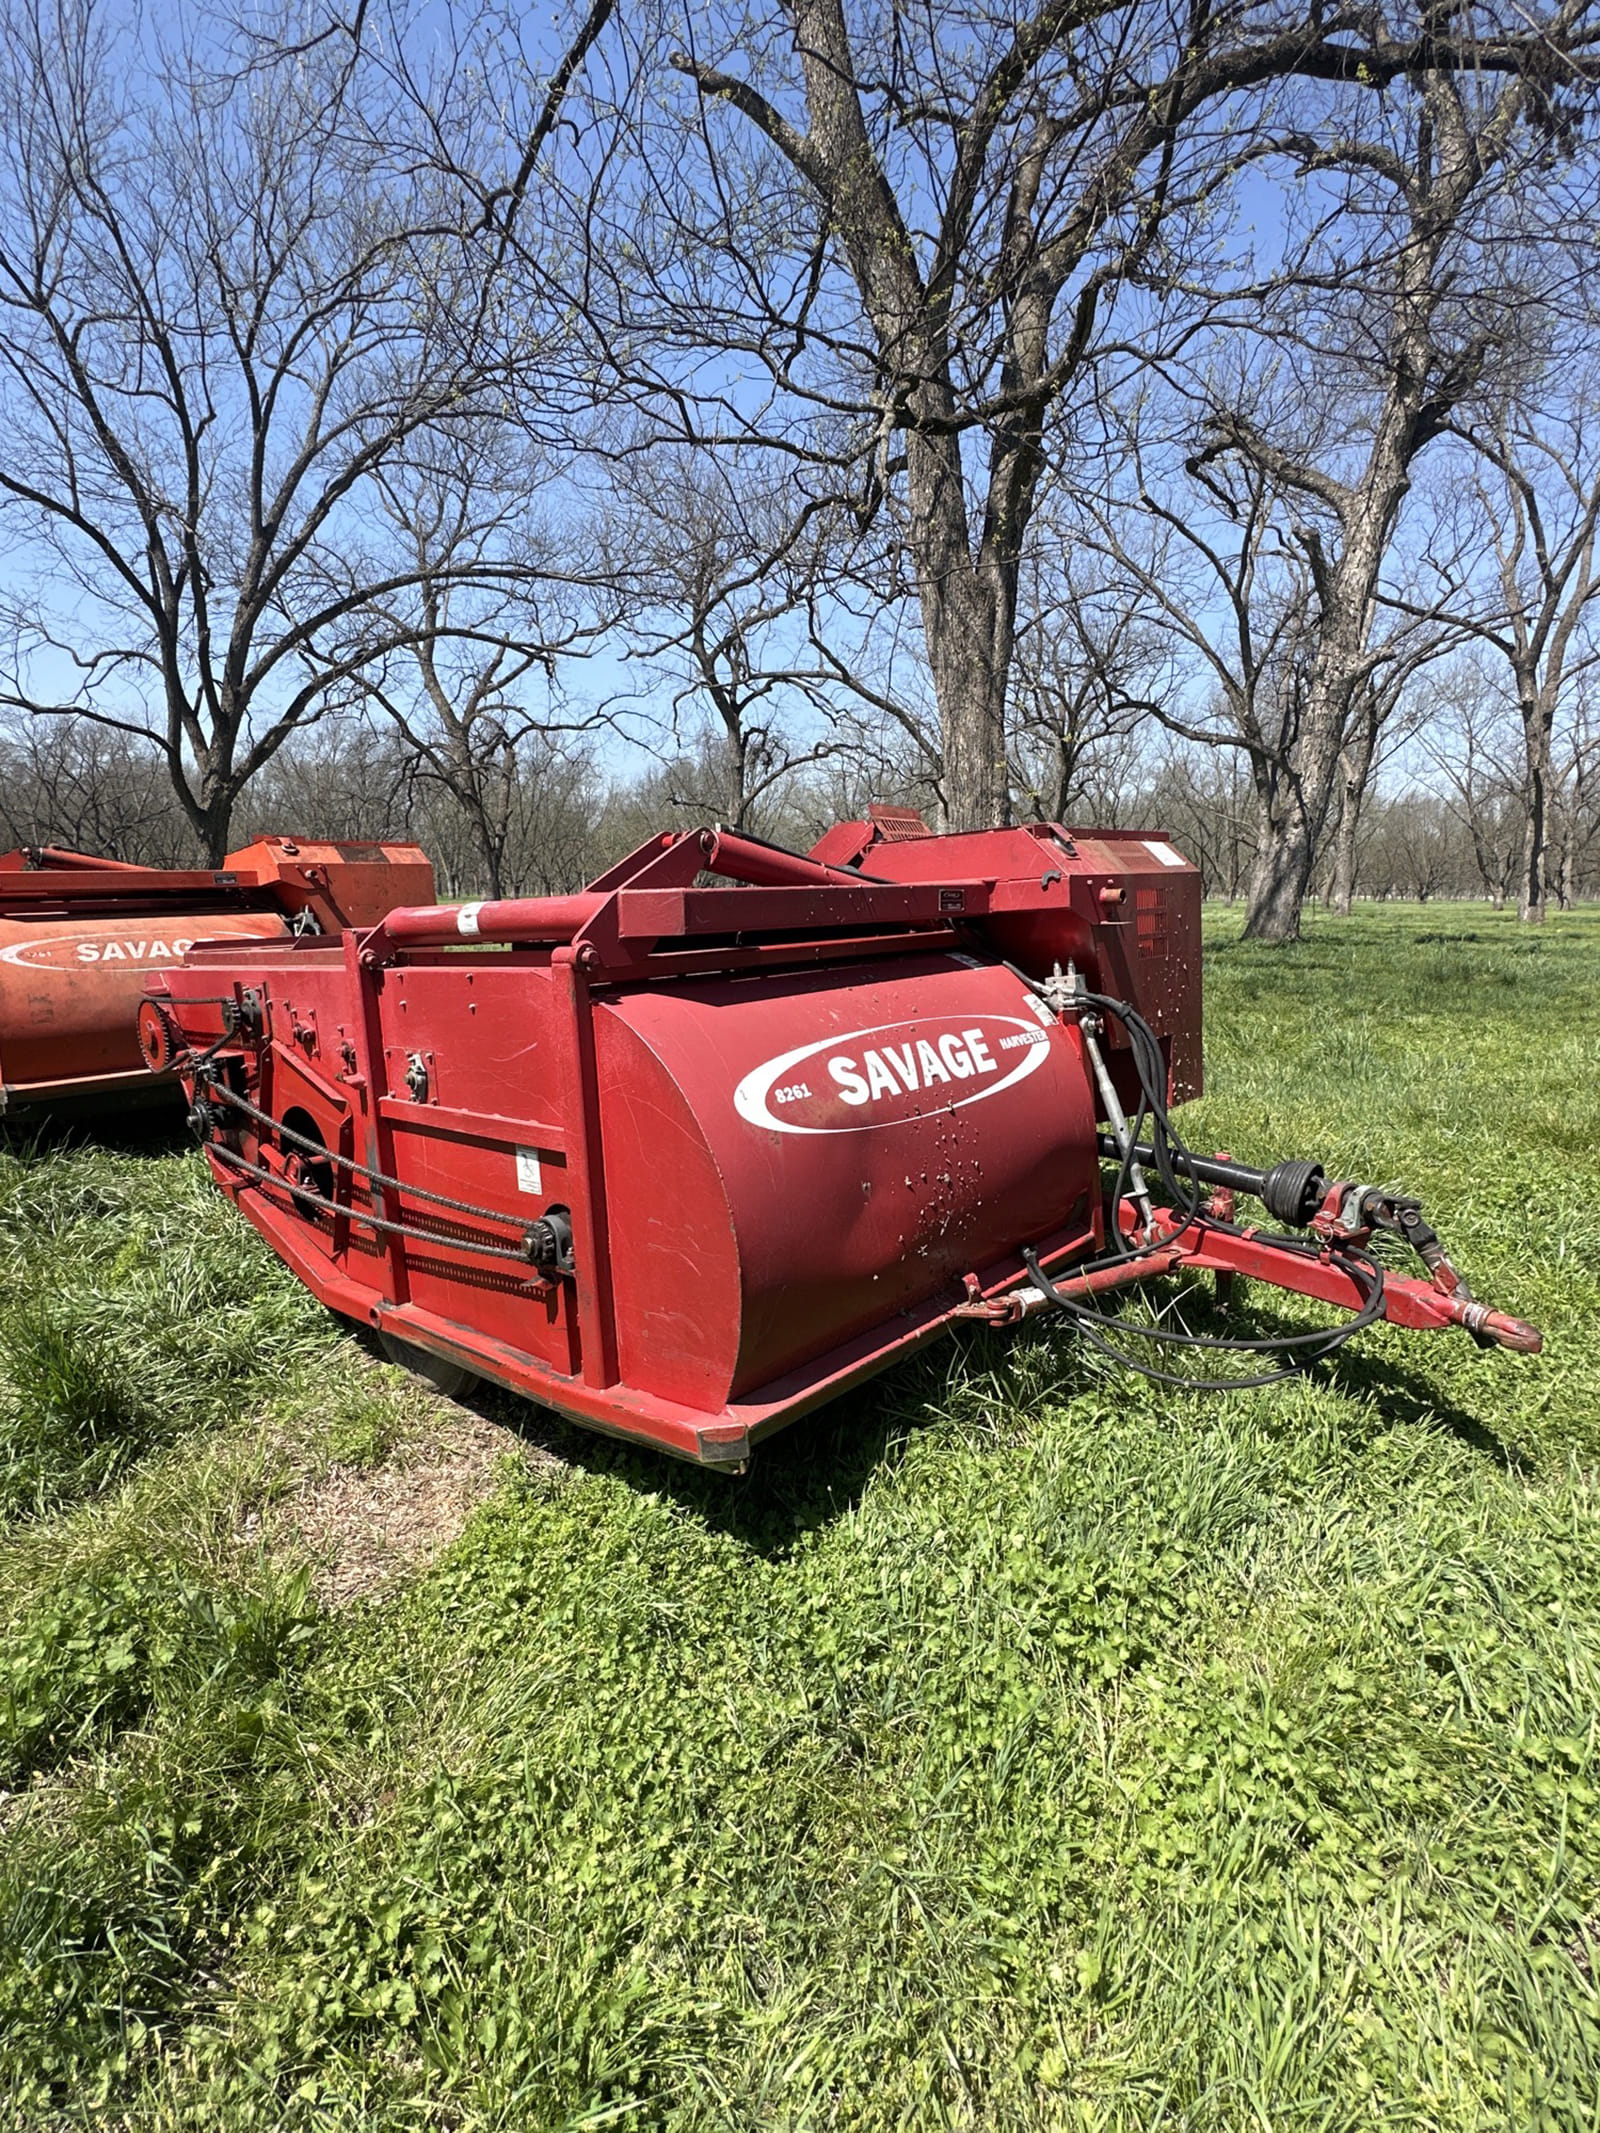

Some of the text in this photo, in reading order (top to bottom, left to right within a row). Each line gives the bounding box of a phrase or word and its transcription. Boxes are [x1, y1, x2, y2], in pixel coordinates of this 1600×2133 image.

[76, 938, 214, 962] SAVAG
[775, 1028, 1048, 1106] 8261 SAVAGE HARVESTER
